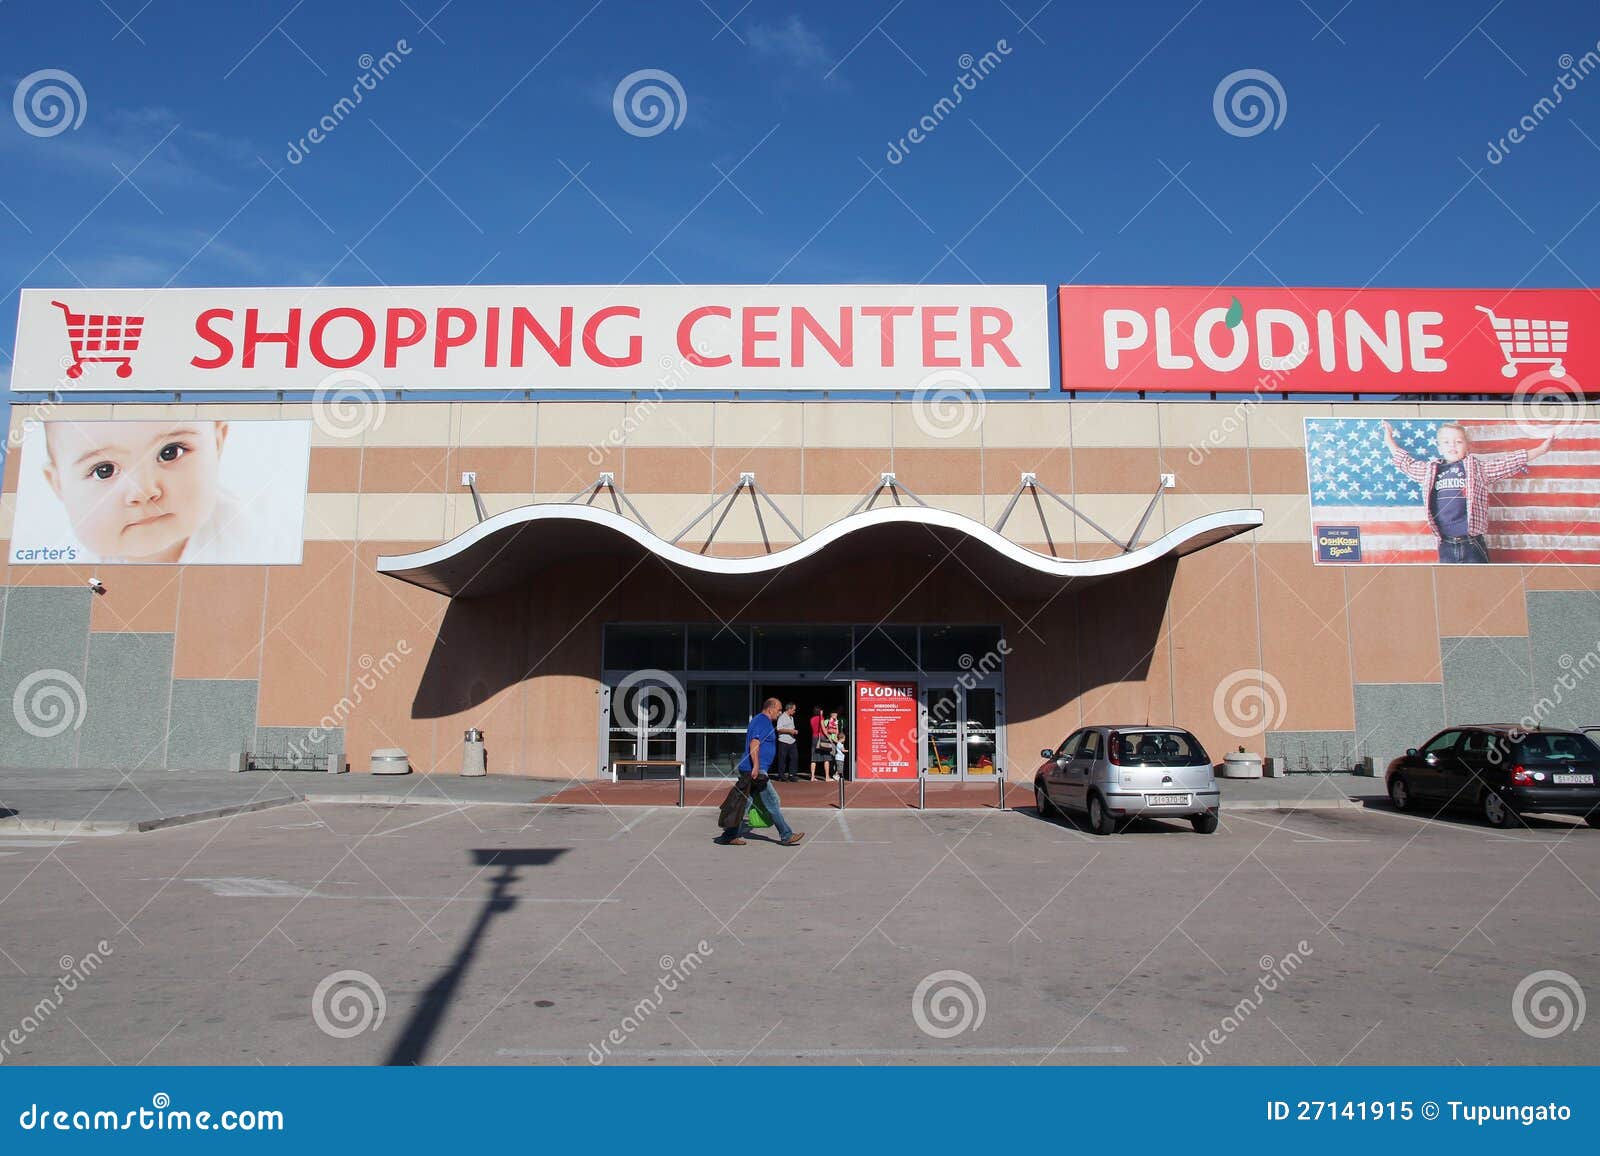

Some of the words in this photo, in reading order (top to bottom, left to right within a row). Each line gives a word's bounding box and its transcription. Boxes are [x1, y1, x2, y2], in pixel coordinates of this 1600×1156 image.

[190, 306, 643, 369] SHOPPING
[676, 305, 1022, 368] CENTER
[1103, 302, 1448, 373] PLODINE
[15, 546, 77, 561] carter's
[860, 687, 913, 697] PLODINE
